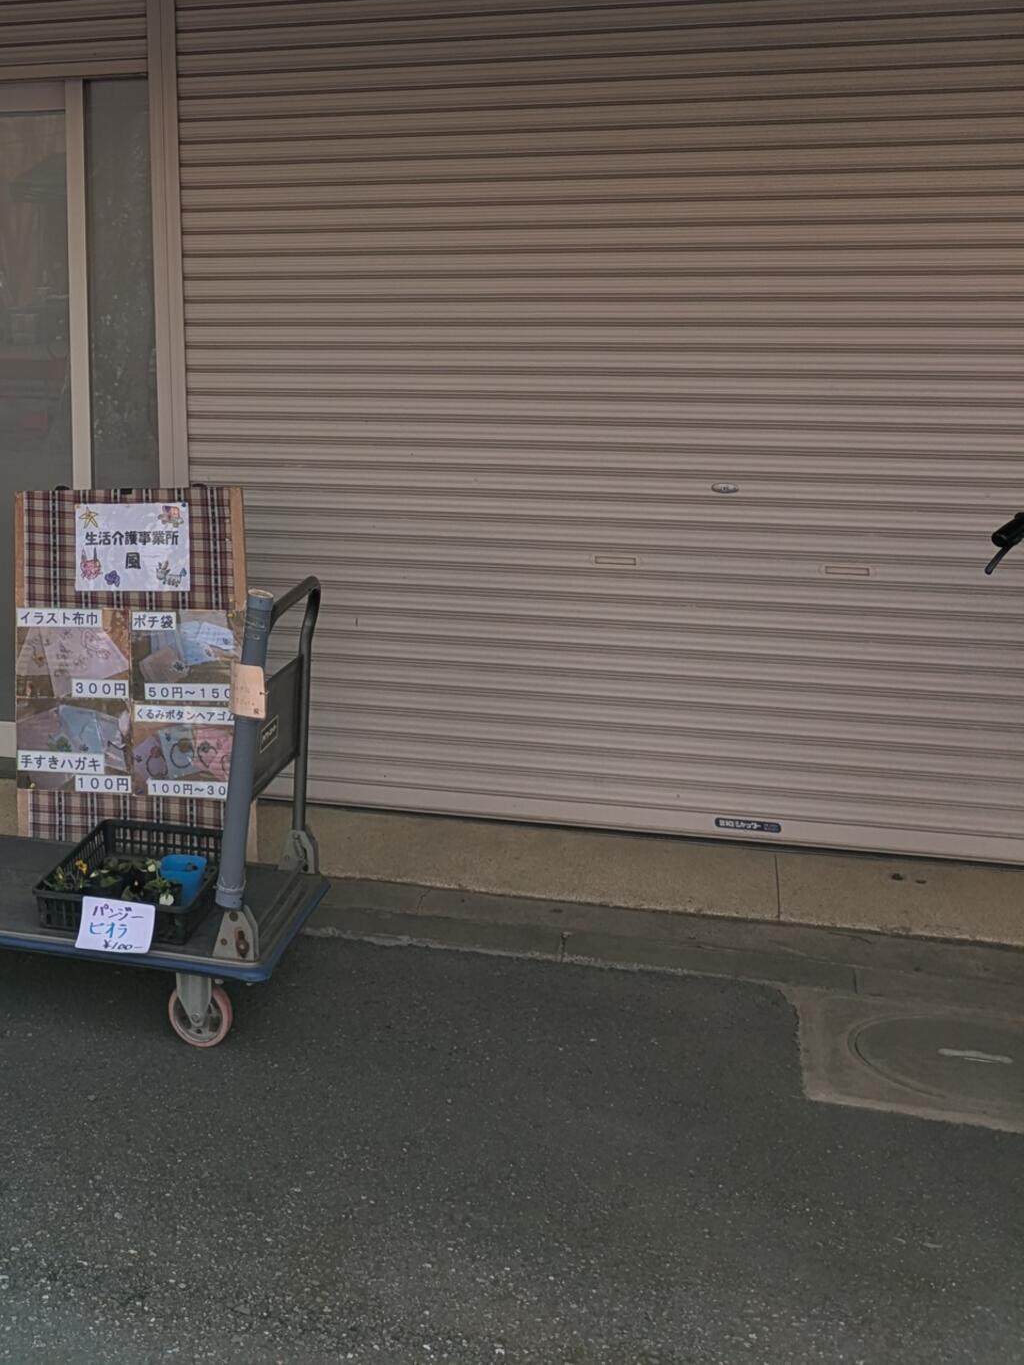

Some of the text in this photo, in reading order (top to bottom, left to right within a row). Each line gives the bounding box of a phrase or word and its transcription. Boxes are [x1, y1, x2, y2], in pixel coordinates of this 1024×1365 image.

[85, 531, 179, 546] 生活介護事業所
[125, 552, 141, 569] 風
[20, 611, 98, 626] イラスト布巾
[133, 614, 174, 629] ポチ袋
[76, 682, 126, 696] 300円
[20, 754, 101, 772] 手すきハガキ
[78, 777, 129, 791] 100円
[92, 903, 144, 921] パンジー
